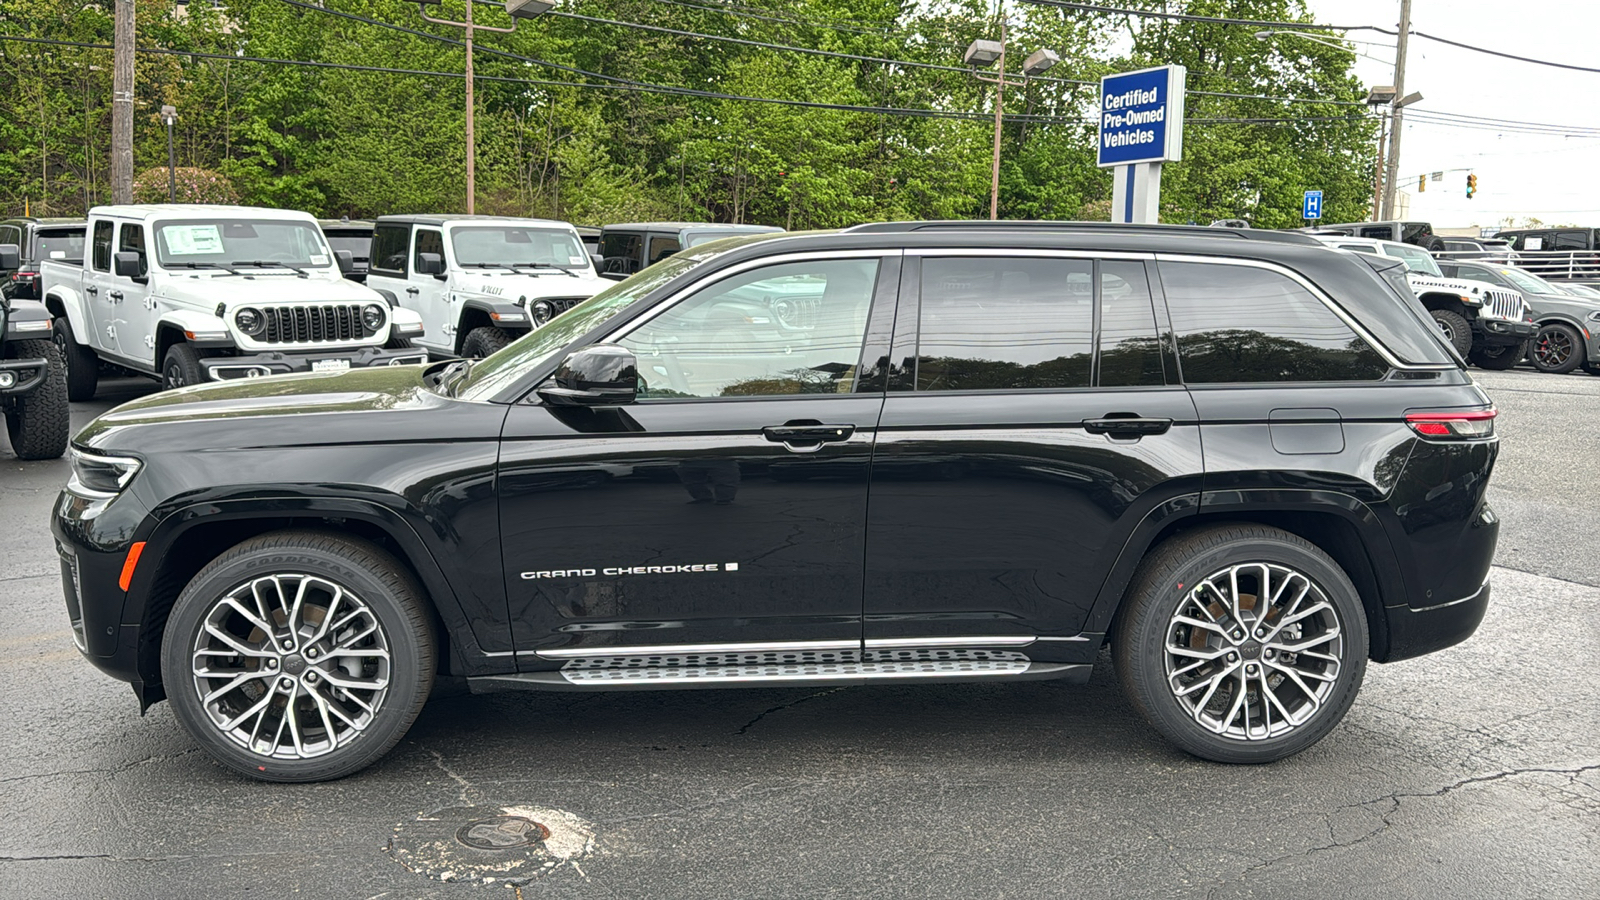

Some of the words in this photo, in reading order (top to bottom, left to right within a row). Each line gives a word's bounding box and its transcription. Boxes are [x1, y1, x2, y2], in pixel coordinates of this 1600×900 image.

[1105, 87, 1157, 109] Certified
[1104, 105, 1165, 129] Pre-Owned
[1103, 129, 1154, 148] Vehicles
[1308, 197, 1318, 211] H
[1412, 280, 1467, 290] RUBICON
[520, 568, 597, 580] GRAND
[602, 563, 719, 576] CHEROKEE
